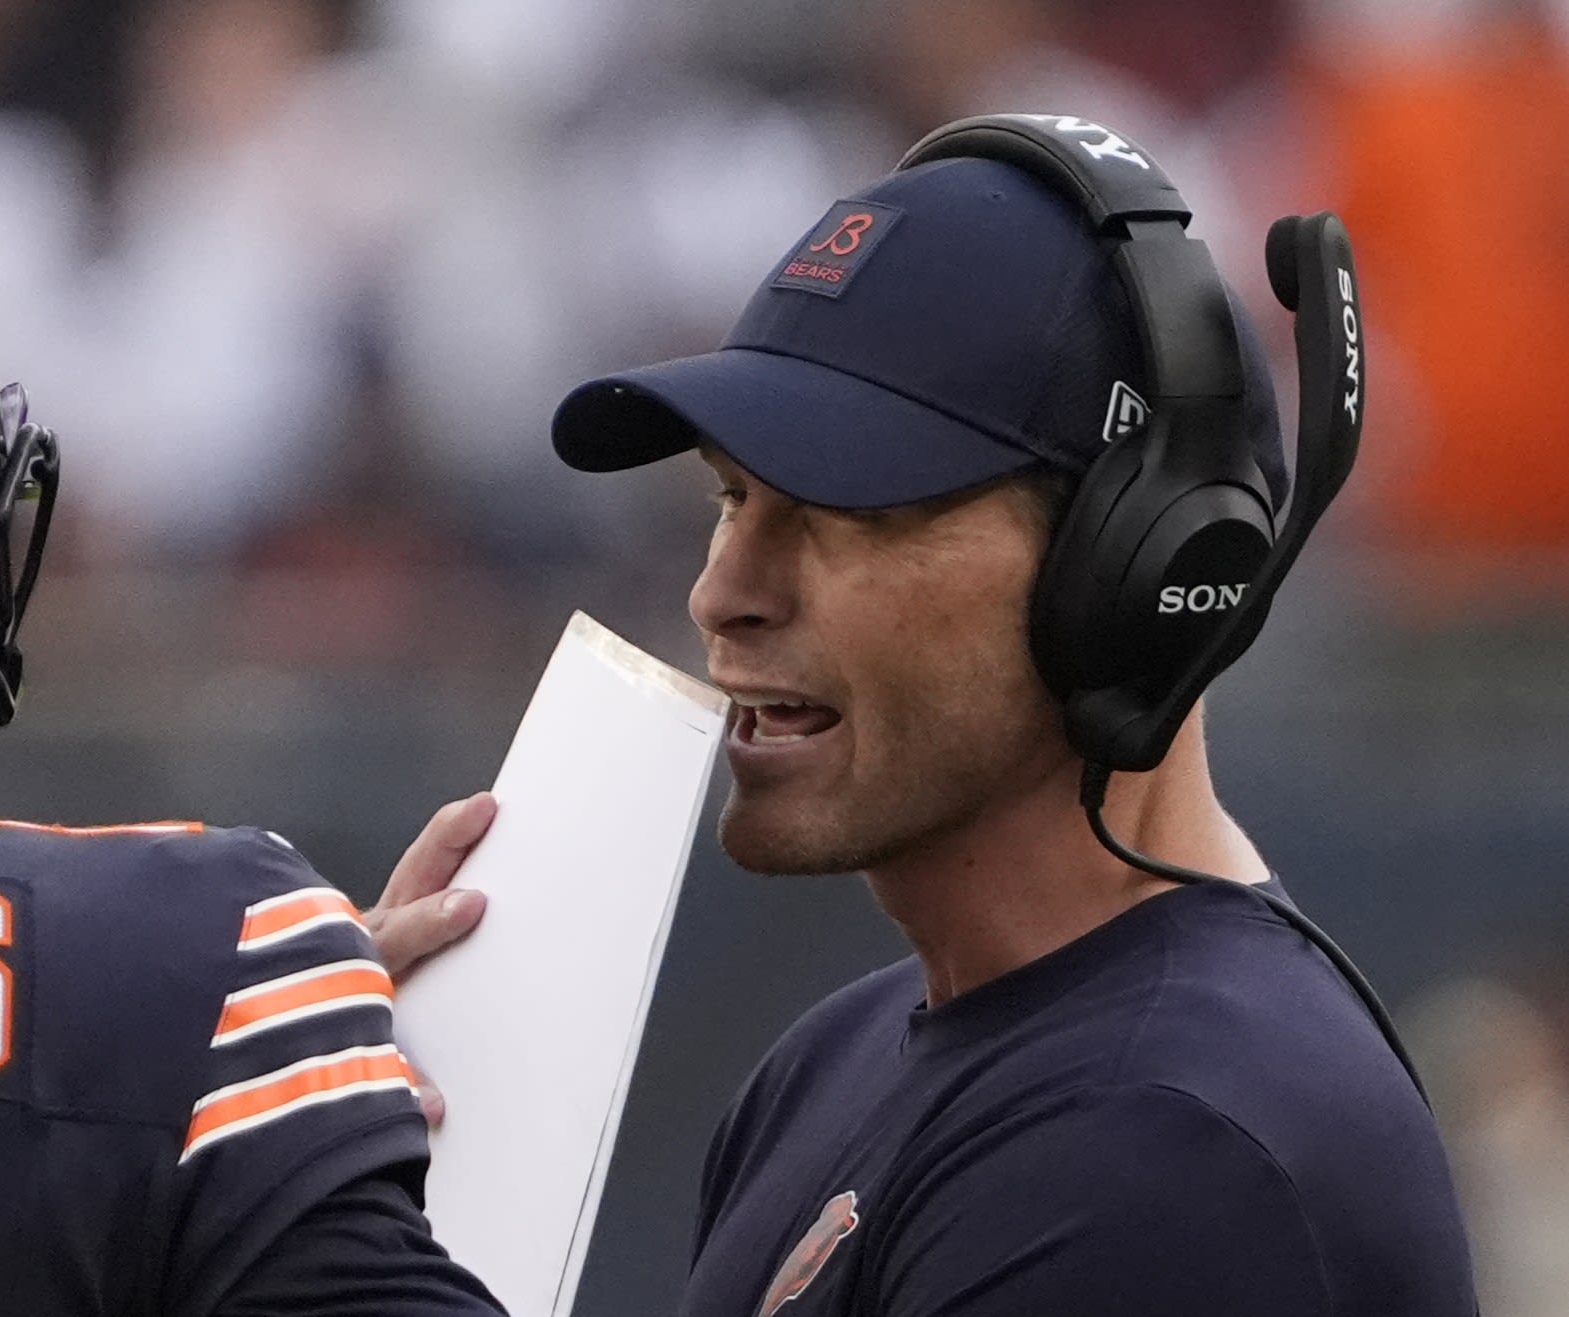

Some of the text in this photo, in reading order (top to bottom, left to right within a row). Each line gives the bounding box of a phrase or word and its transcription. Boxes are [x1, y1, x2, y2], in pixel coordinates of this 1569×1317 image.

[783, 262, 846, 284] BEARS
[1338, 268, 1359, 424] SONY
[1158, 583, 1250, 613] SON
